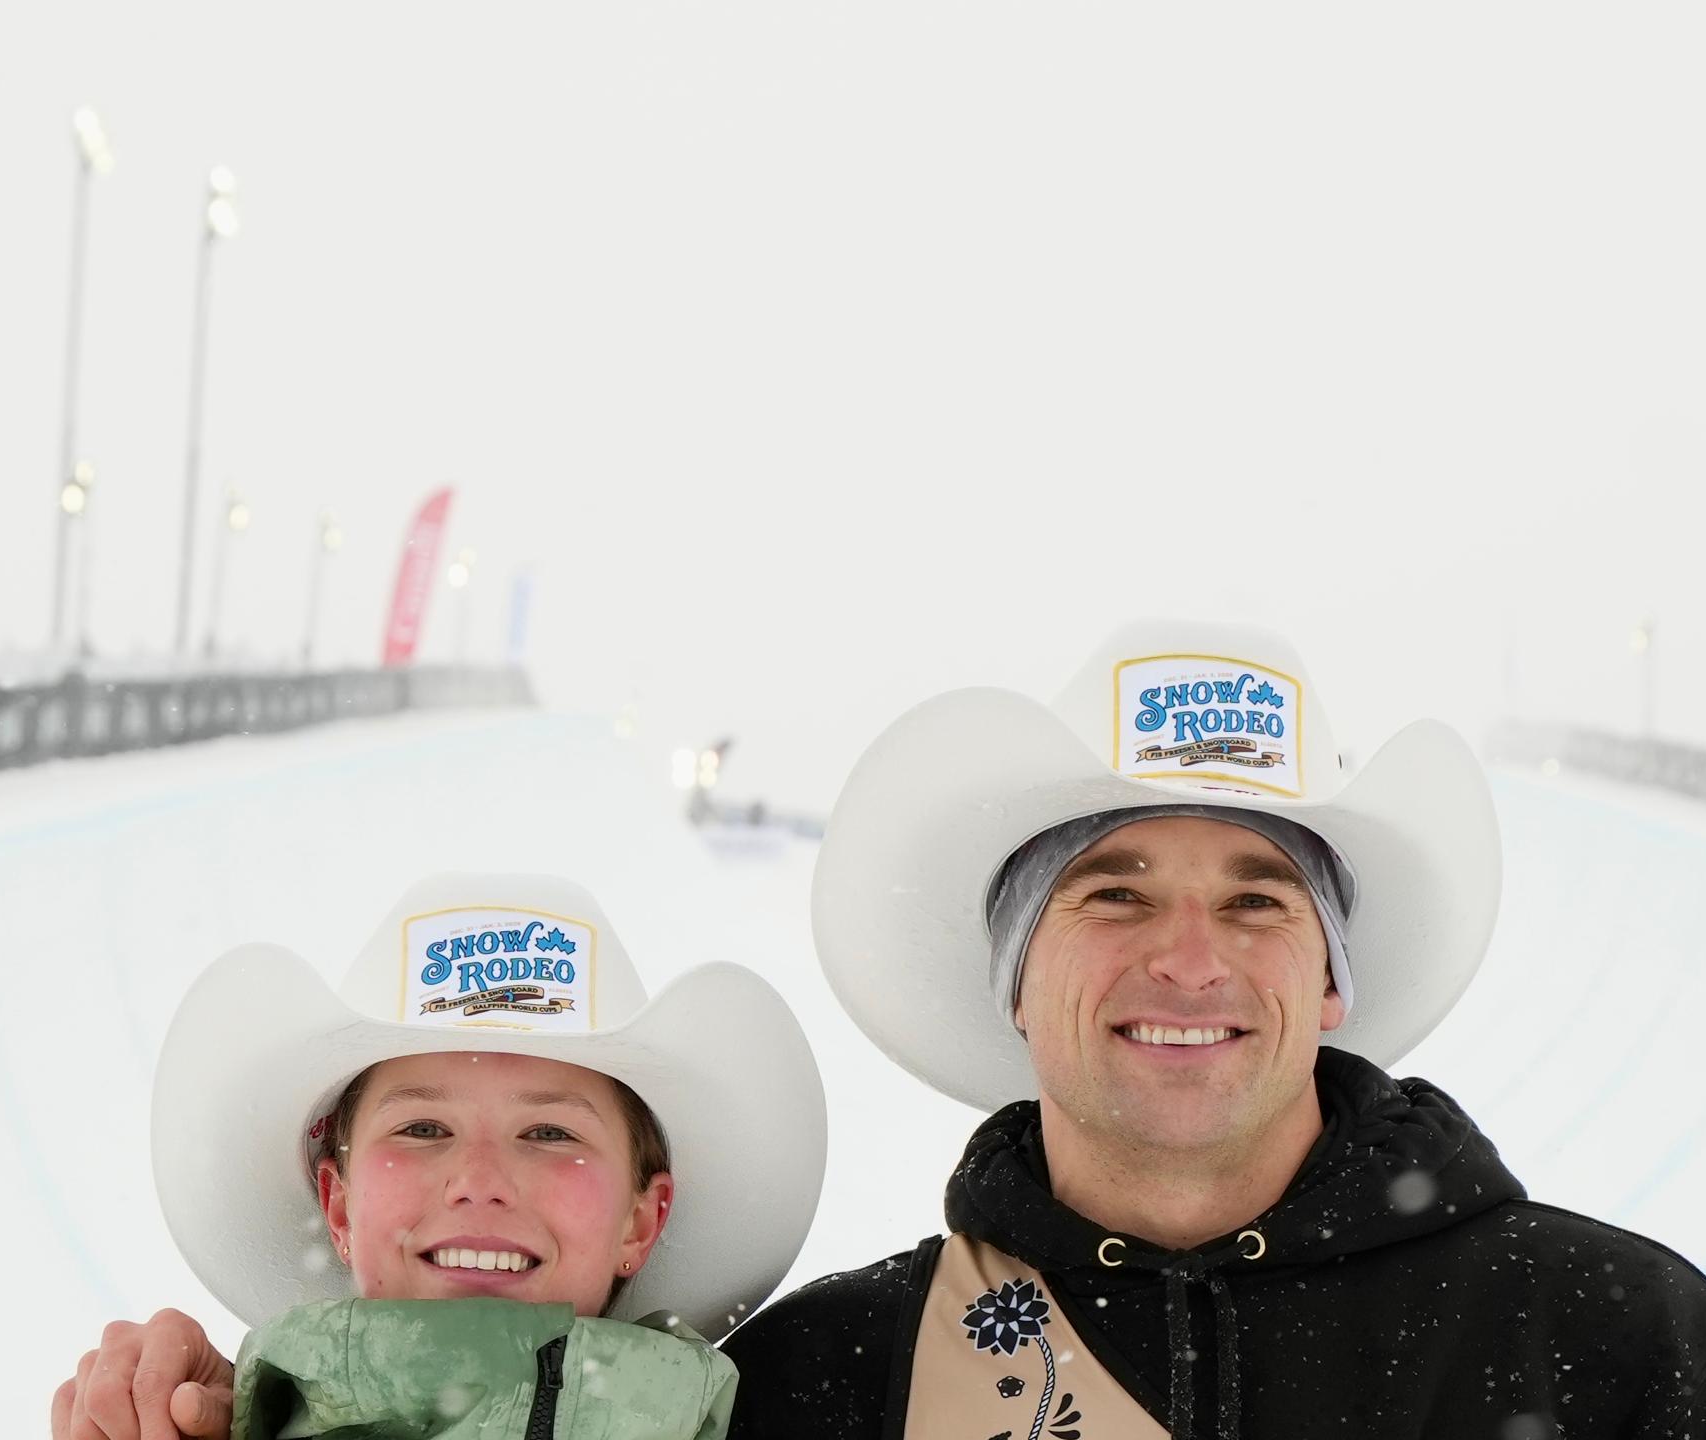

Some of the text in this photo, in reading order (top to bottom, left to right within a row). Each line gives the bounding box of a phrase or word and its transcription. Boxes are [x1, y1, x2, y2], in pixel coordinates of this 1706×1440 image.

[1135, 673, 1255, 732] SNOW
[1172, 708, 1284, 755] RODEO
[1226, 755, 1251, 765] WORLD
[421, 921, 544, 985] SNOW
[458, 957, 576, 1003] RODEO
[511, 1004, 538, 1012] WORLD
